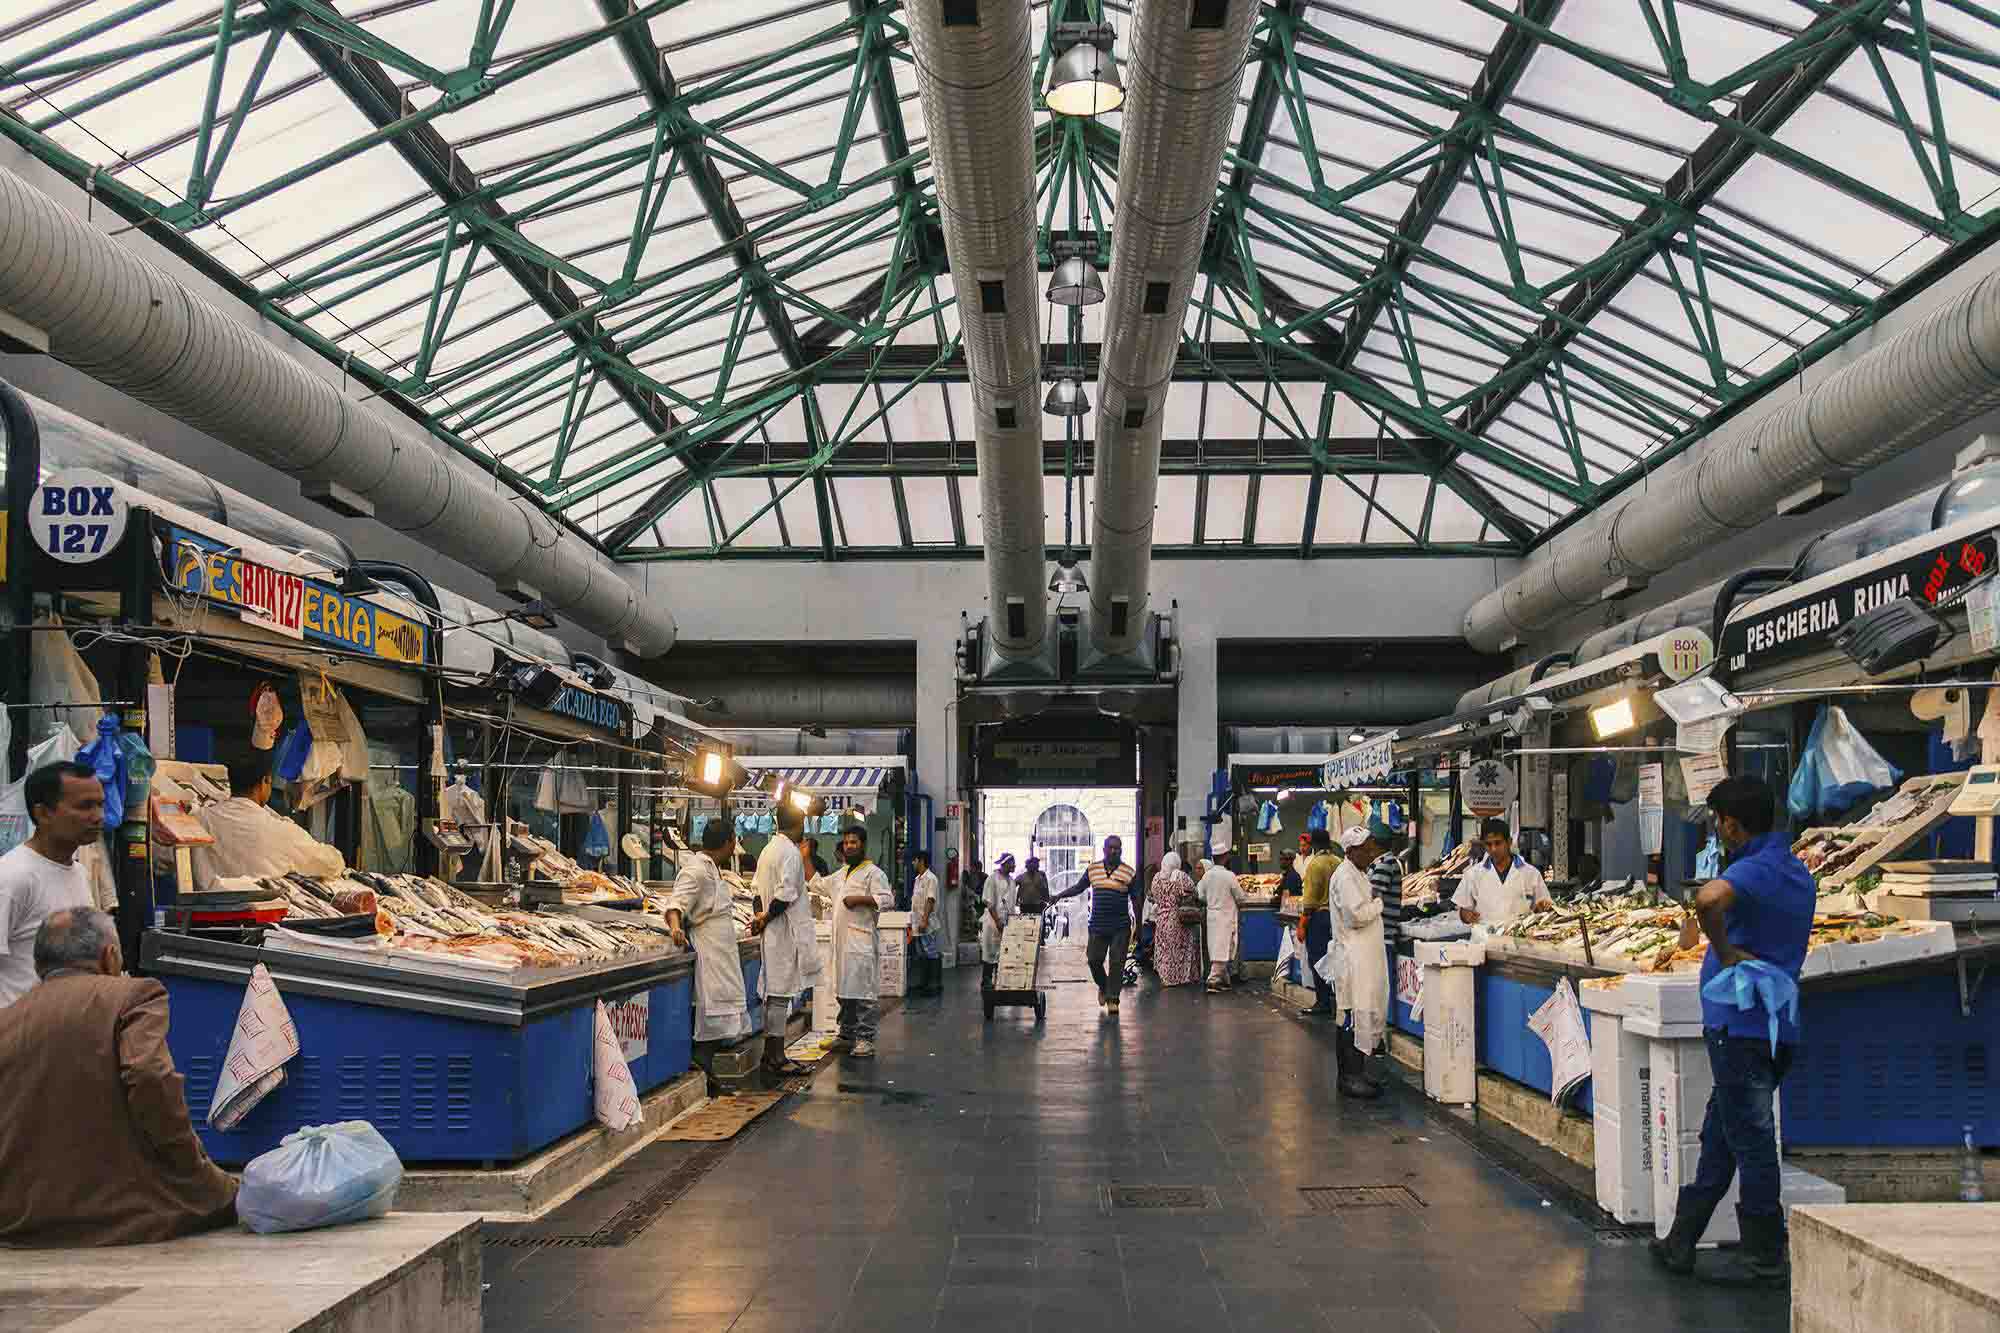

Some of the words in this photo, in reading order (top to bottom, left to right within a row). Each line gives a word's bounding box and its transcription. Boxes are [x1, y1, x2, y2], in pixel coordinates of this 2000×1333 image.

[42, 486, 114, 516] BOX
[48, 523, 109, 553] 127
[1747, 597, 1839, 654] PESCHERIA
[1673, 639, 1699, 652] BOX
